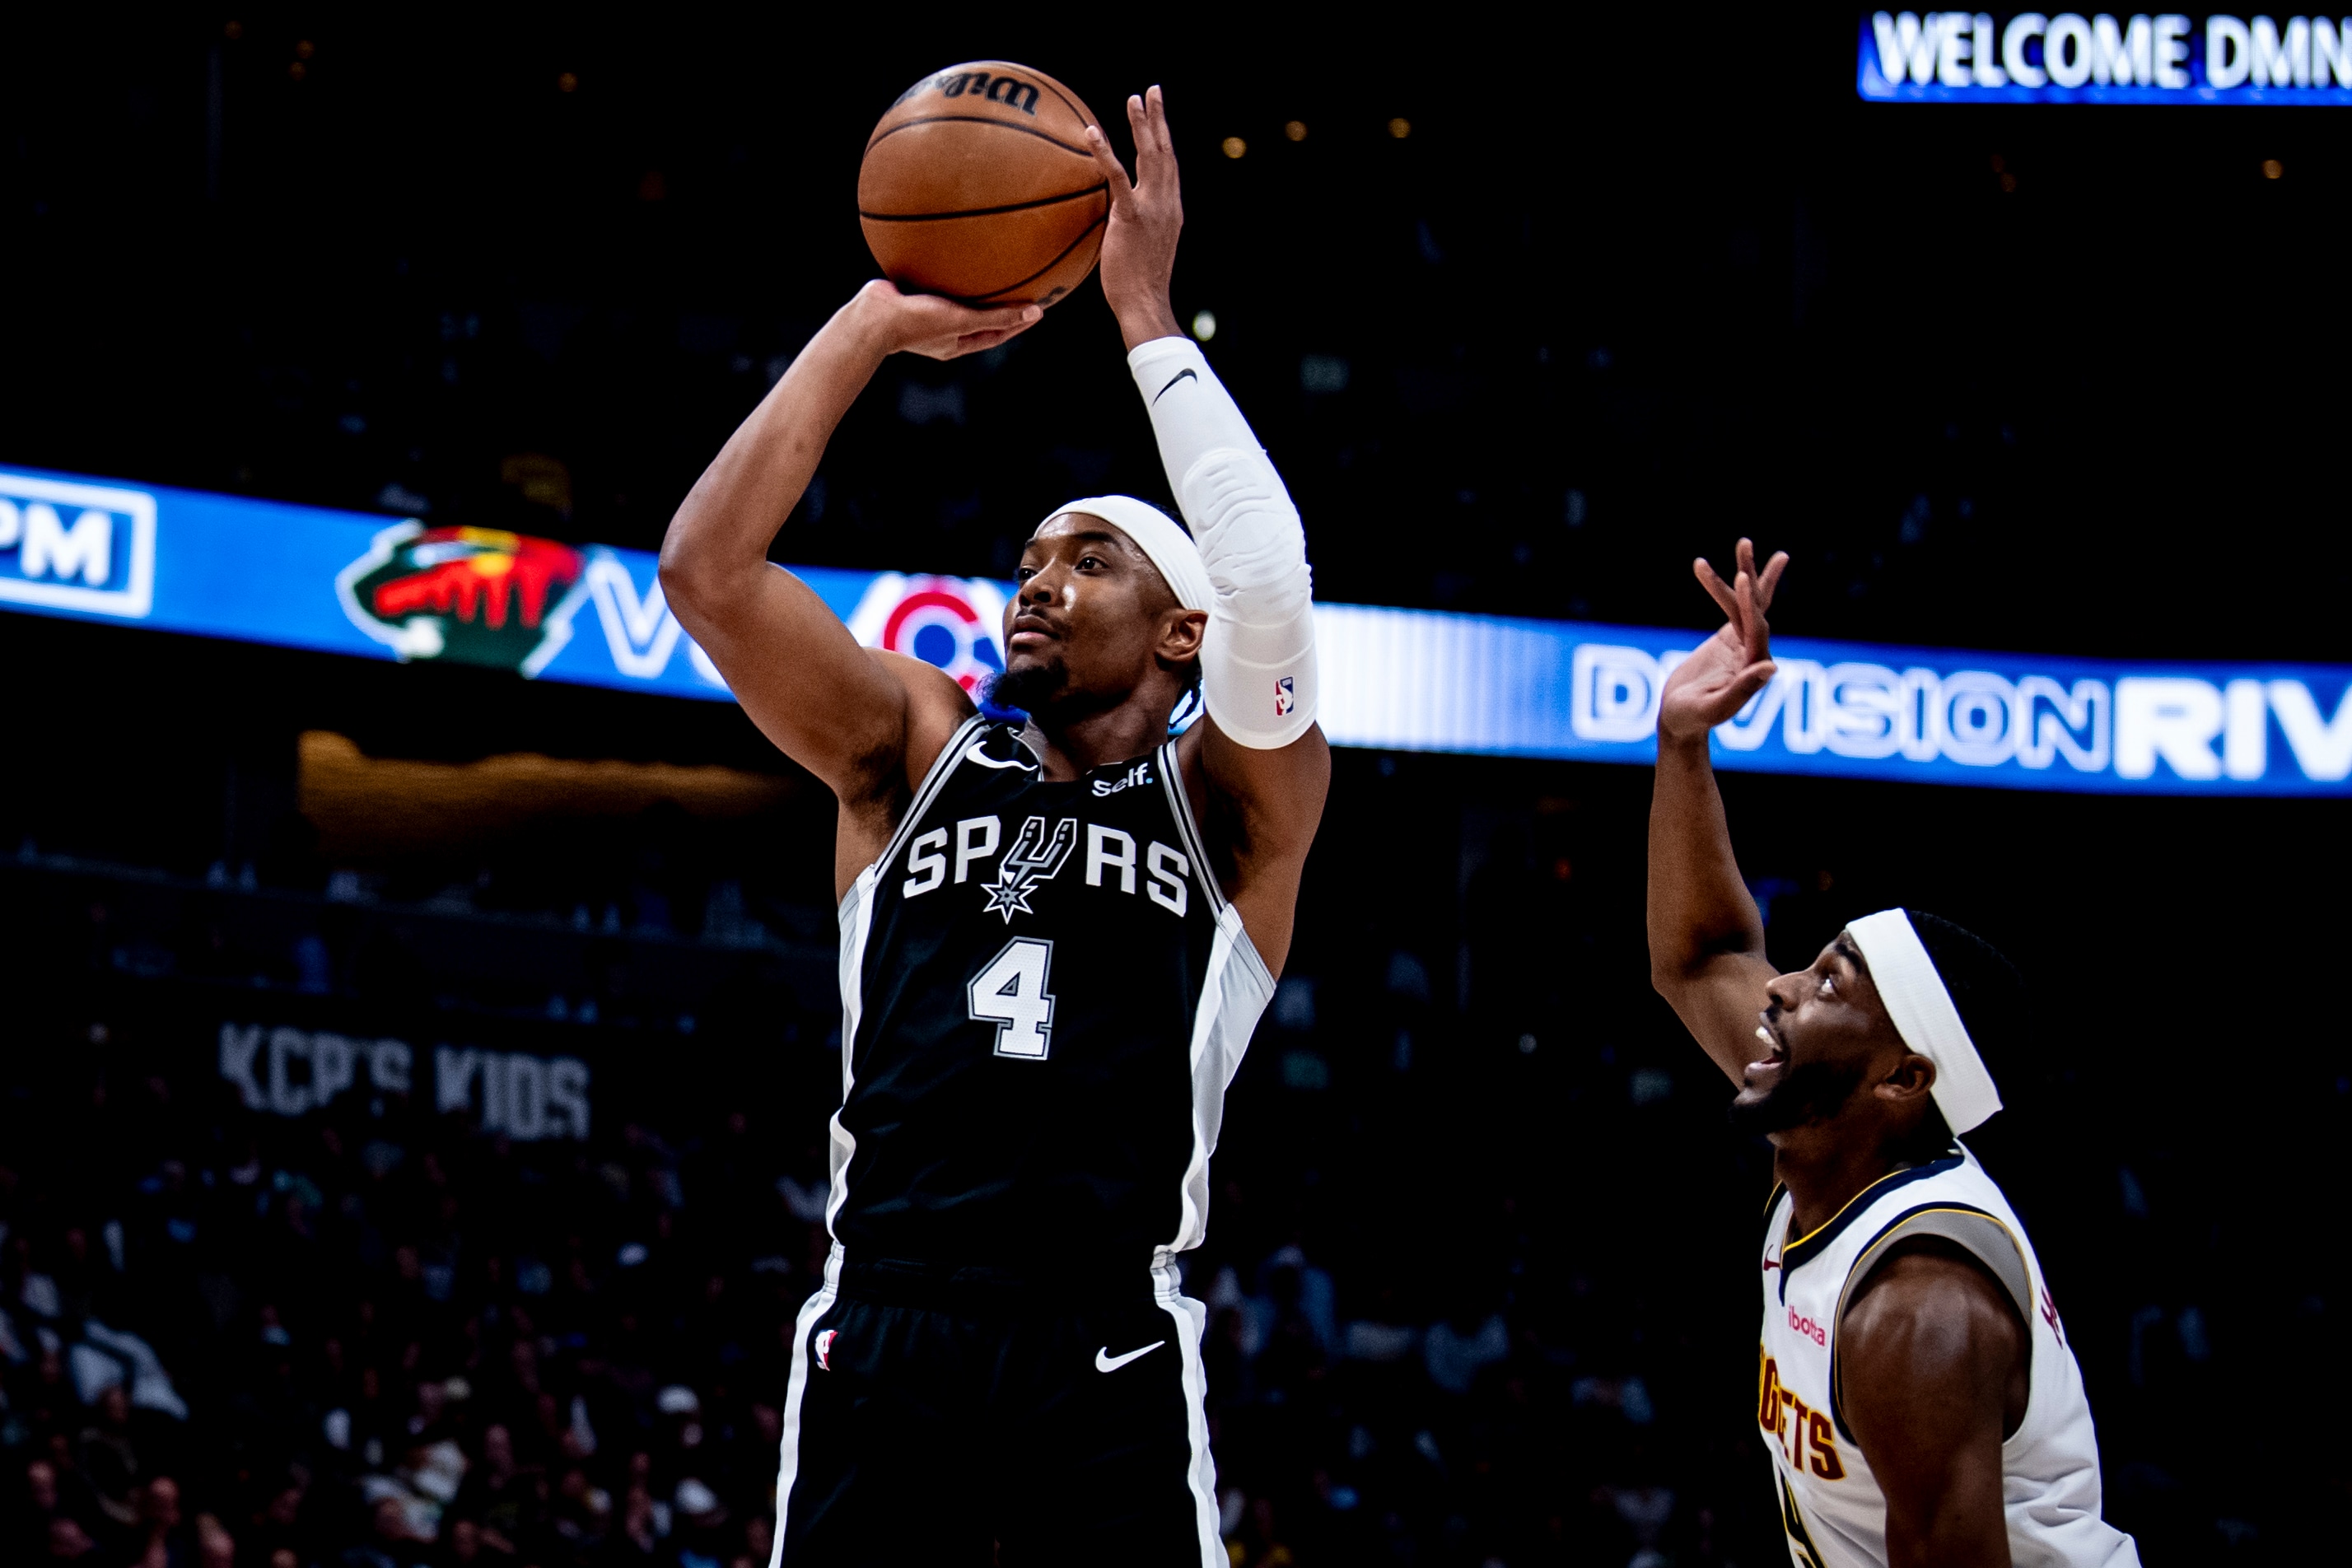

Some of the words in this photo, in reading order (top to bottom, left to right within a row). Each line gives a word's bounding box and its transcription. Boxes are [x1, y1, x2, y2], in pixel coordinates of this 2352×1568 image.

[885, 72, 1040, 116] Wil
[1872, 10, 2191, 89] WELCOME
[1571, 642, 2111, 774] DVISION
[1091, 762, 1154, 797] Self.
[903, 814, 1190, 925] SPURS
[967, 936, 1057, 1062] 4
[434, 1043, 590, 1141] KIDS
[1788, 1304, 1826, 1346] ibotta
[1758, 1342, 1846, 1482] GETS
